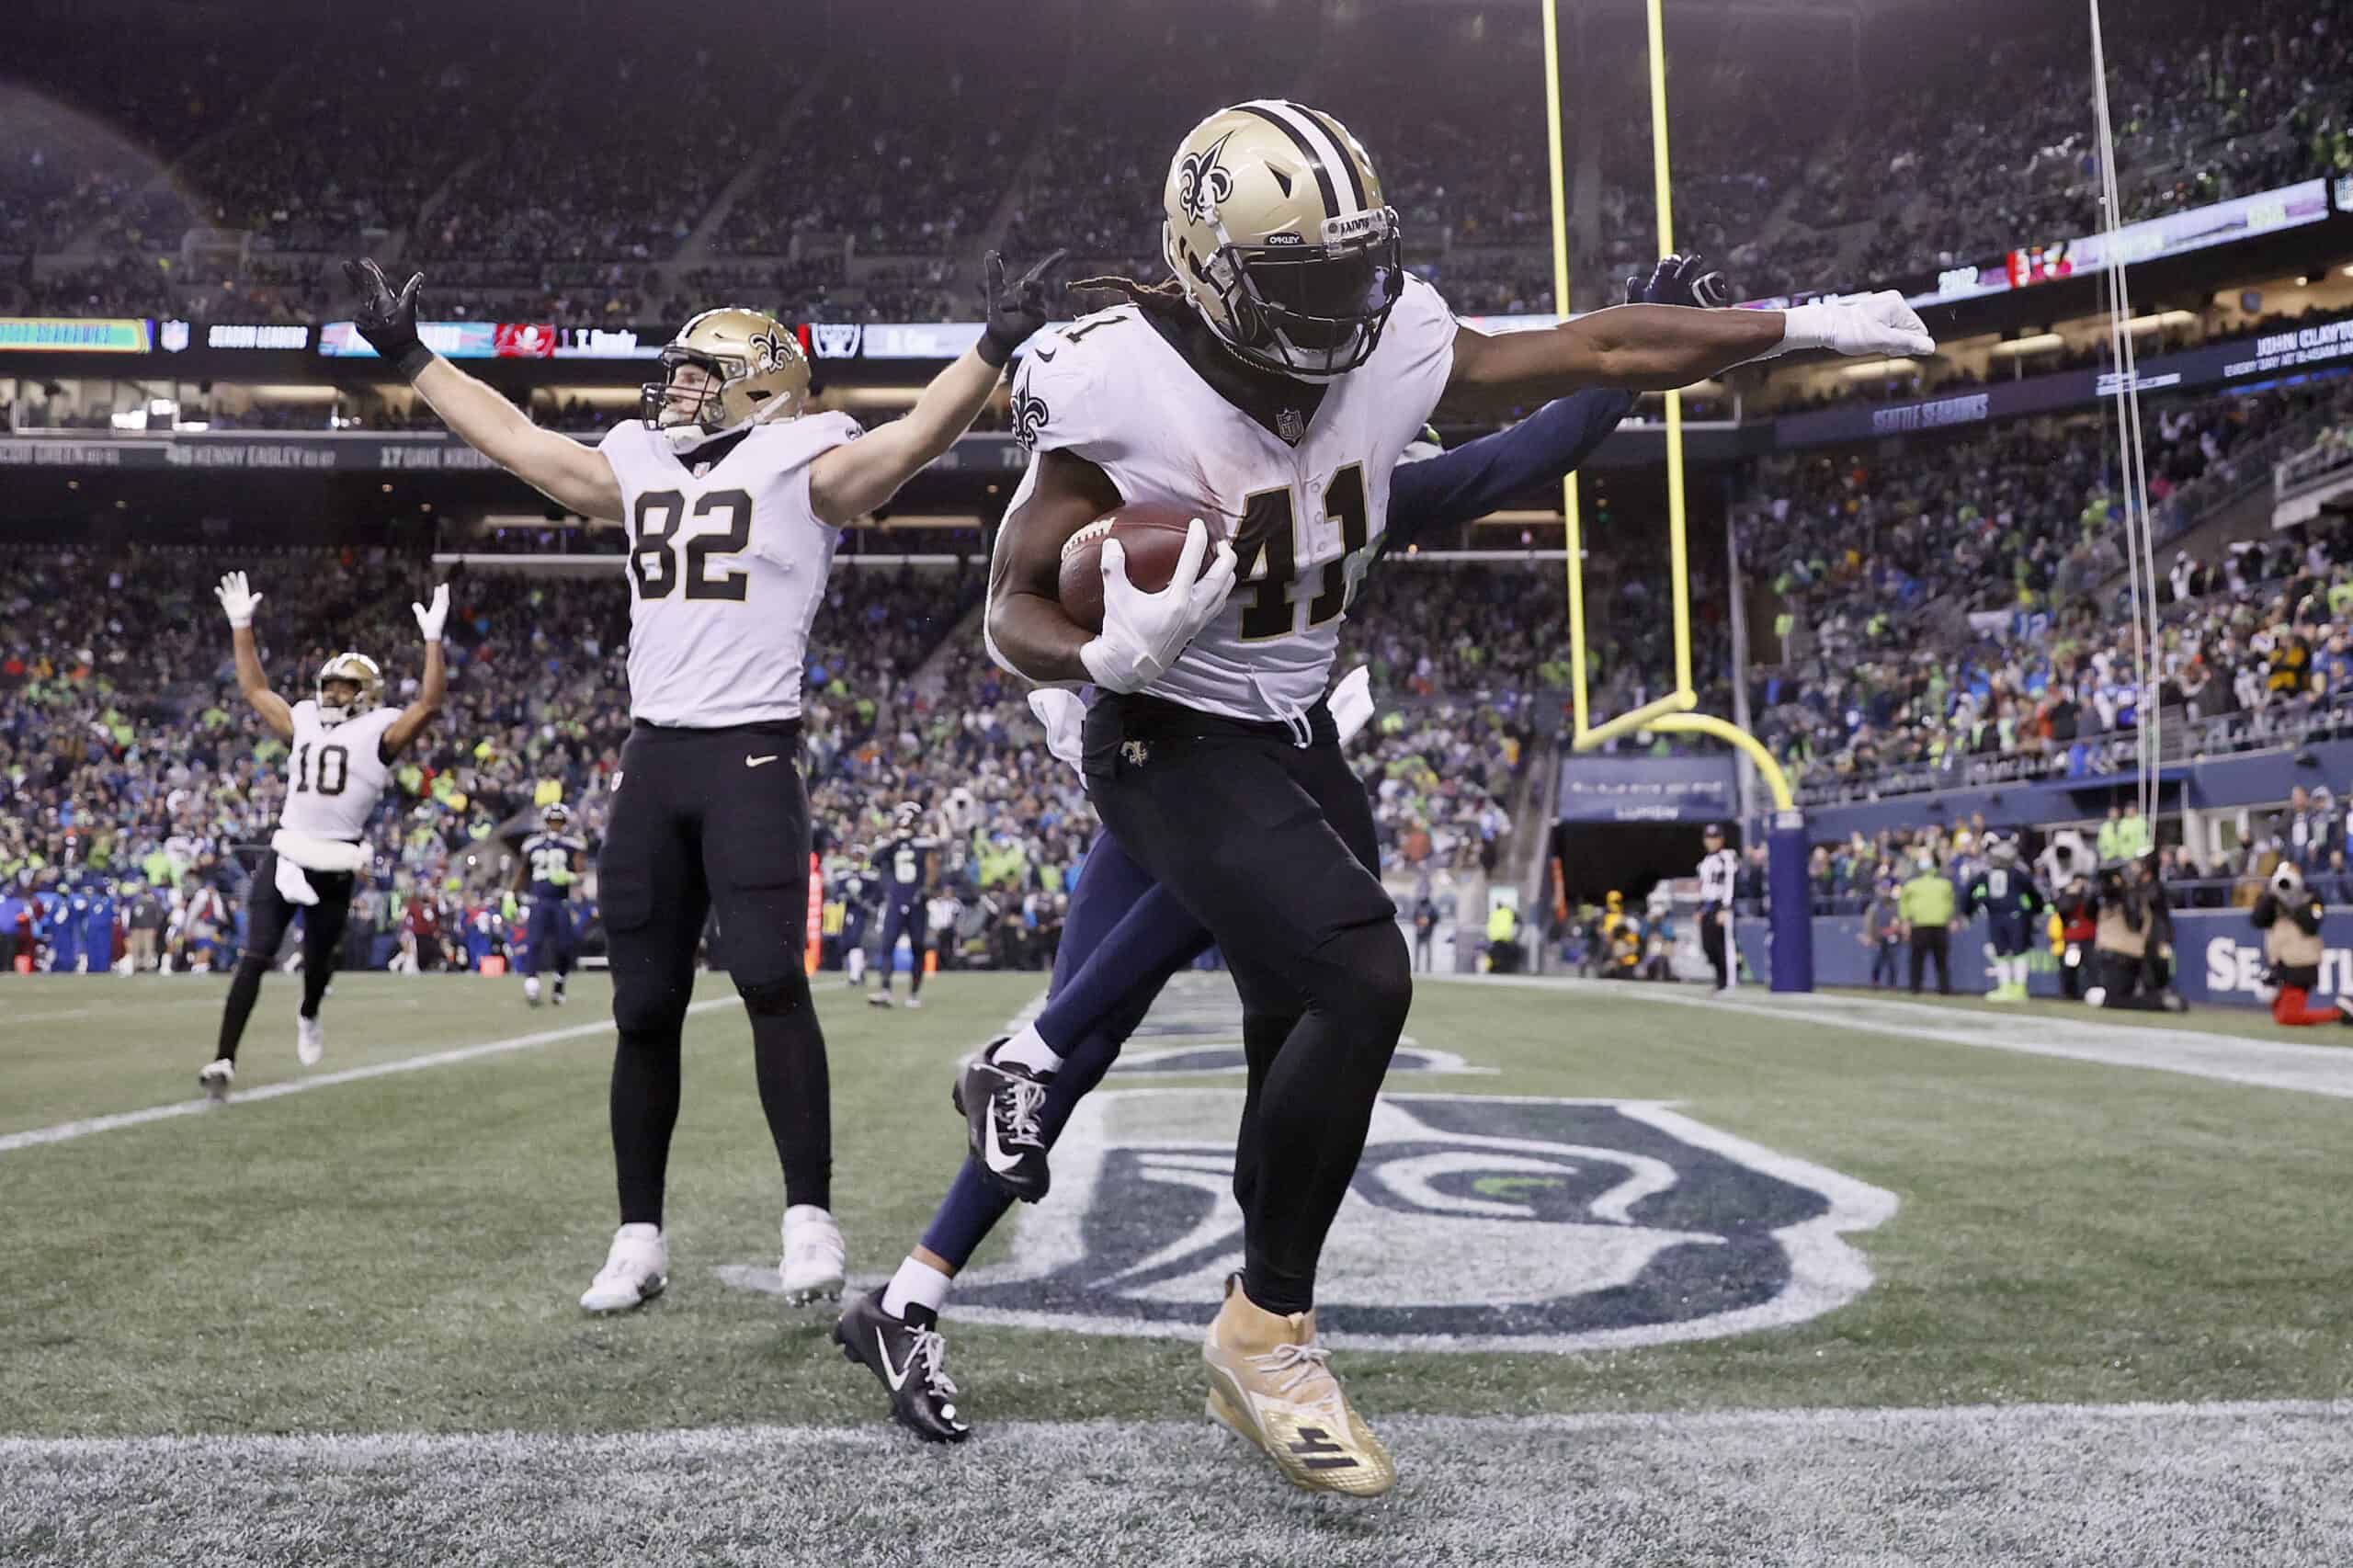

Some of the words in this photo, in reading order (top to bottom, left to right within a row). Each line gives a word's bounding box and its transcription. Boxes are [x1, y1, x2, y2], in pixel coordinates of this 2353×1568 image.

[1268, 235, 1301, 244] OAKLEY
[2256, 332, 2298, 357] JOHN
[1873, 404, 1921, 432] SEATTLE
[1921, 392, 1989, 426] SEAHAWKS
[193, 445, 245, 467] KENNY
[245, 445, 303, 467] EASLEY
[381, 447, 403, 468] 17
[1002, 447, 1024, 467] 71
[631, 488, 755, 603] 82
[1233, 460, 1370, 643] 41
[296, 742, 348, 796] 10
[894, 849, 917, 883] 6
